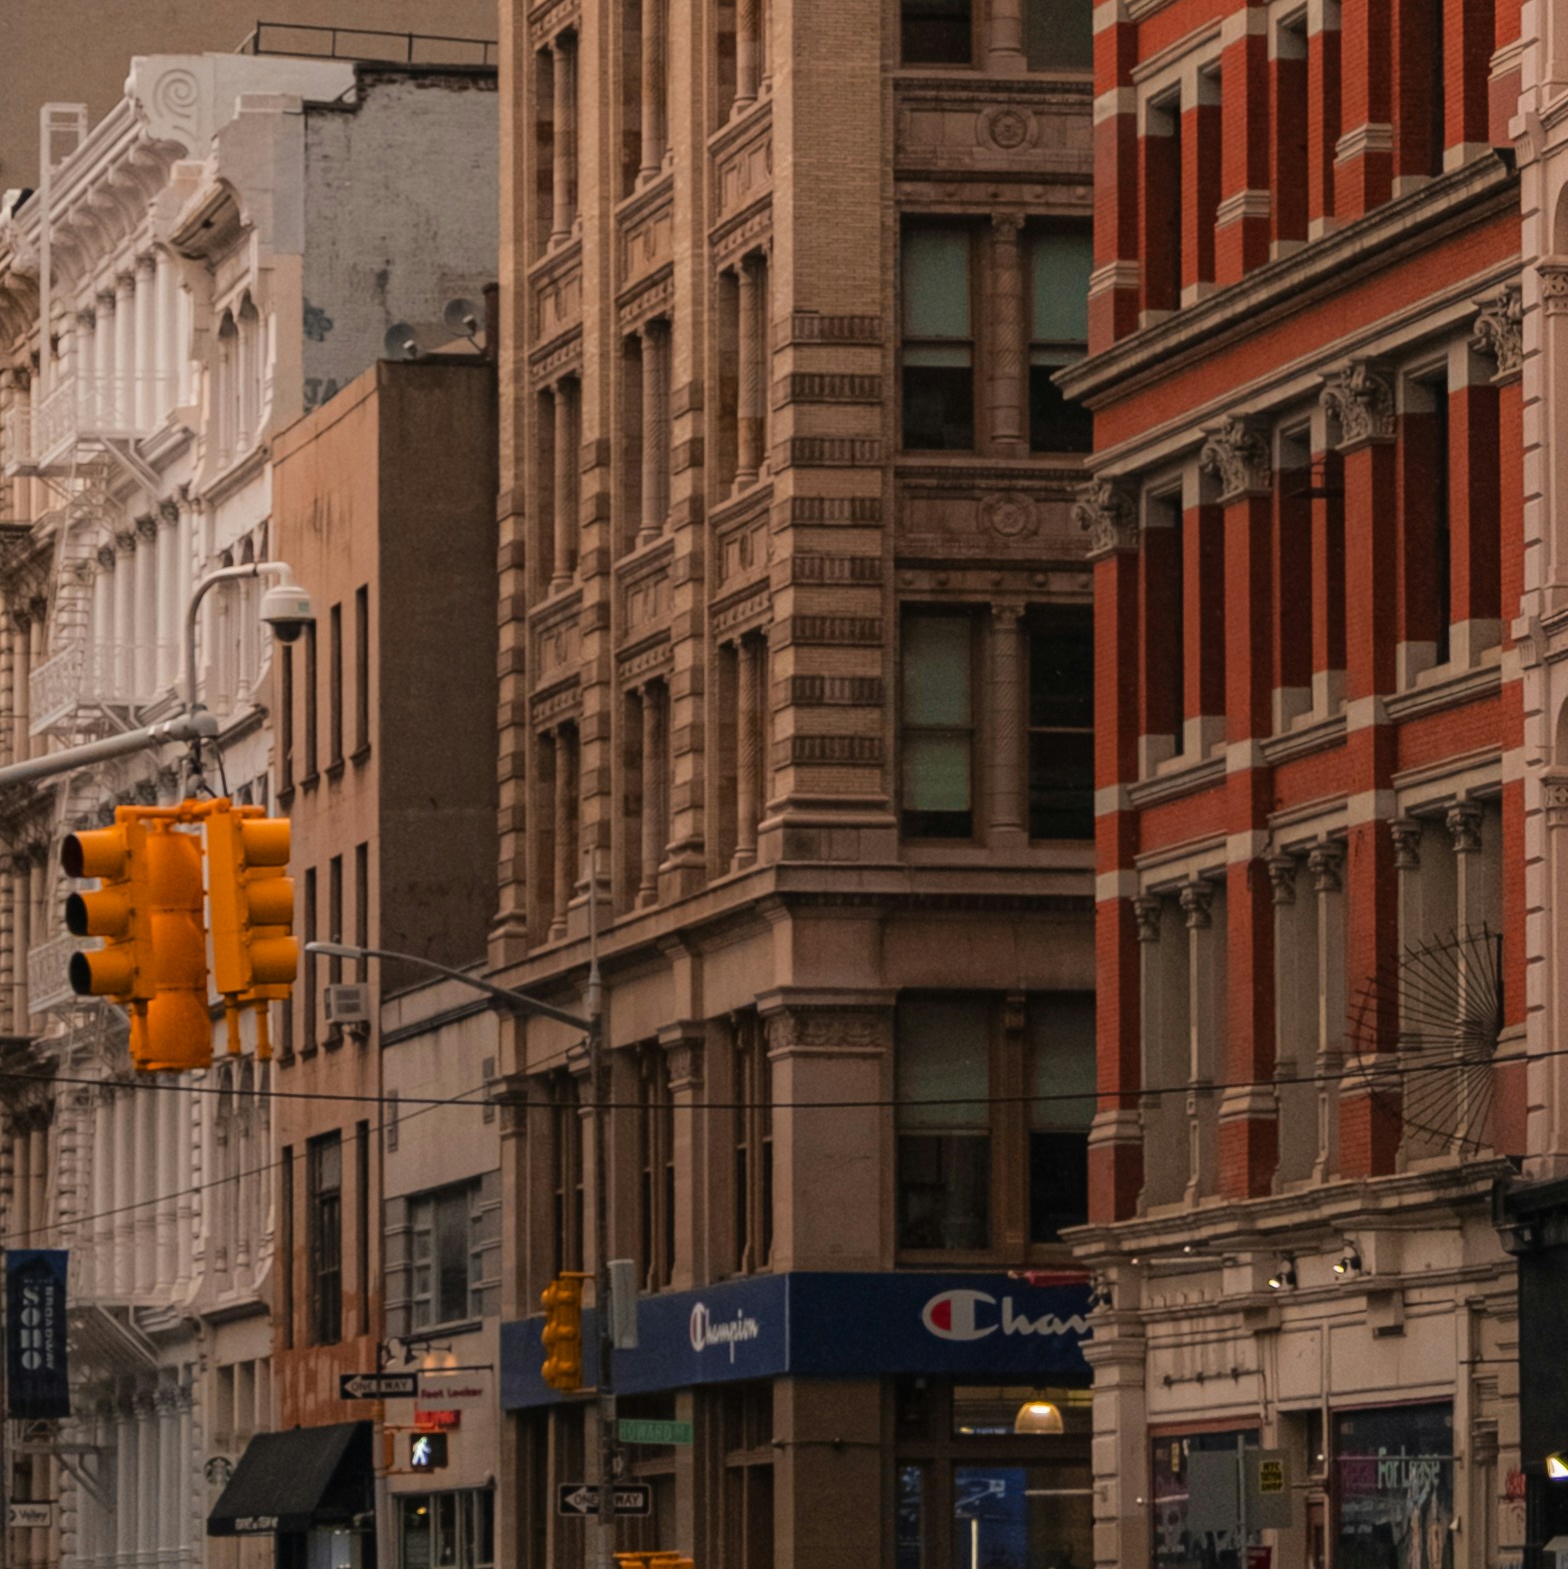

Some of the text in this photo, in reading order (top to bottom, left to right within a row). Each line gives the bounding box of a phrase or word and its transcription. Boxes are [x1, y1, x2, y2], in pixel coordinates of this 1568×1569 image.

[689, 1301, 759, 1364] Champion
[351, 1379, 409, 1393] ONE WAY
[420, 1388, 444, 1399] Foot
[573, 1493, 640, 1506] ONE WAY
